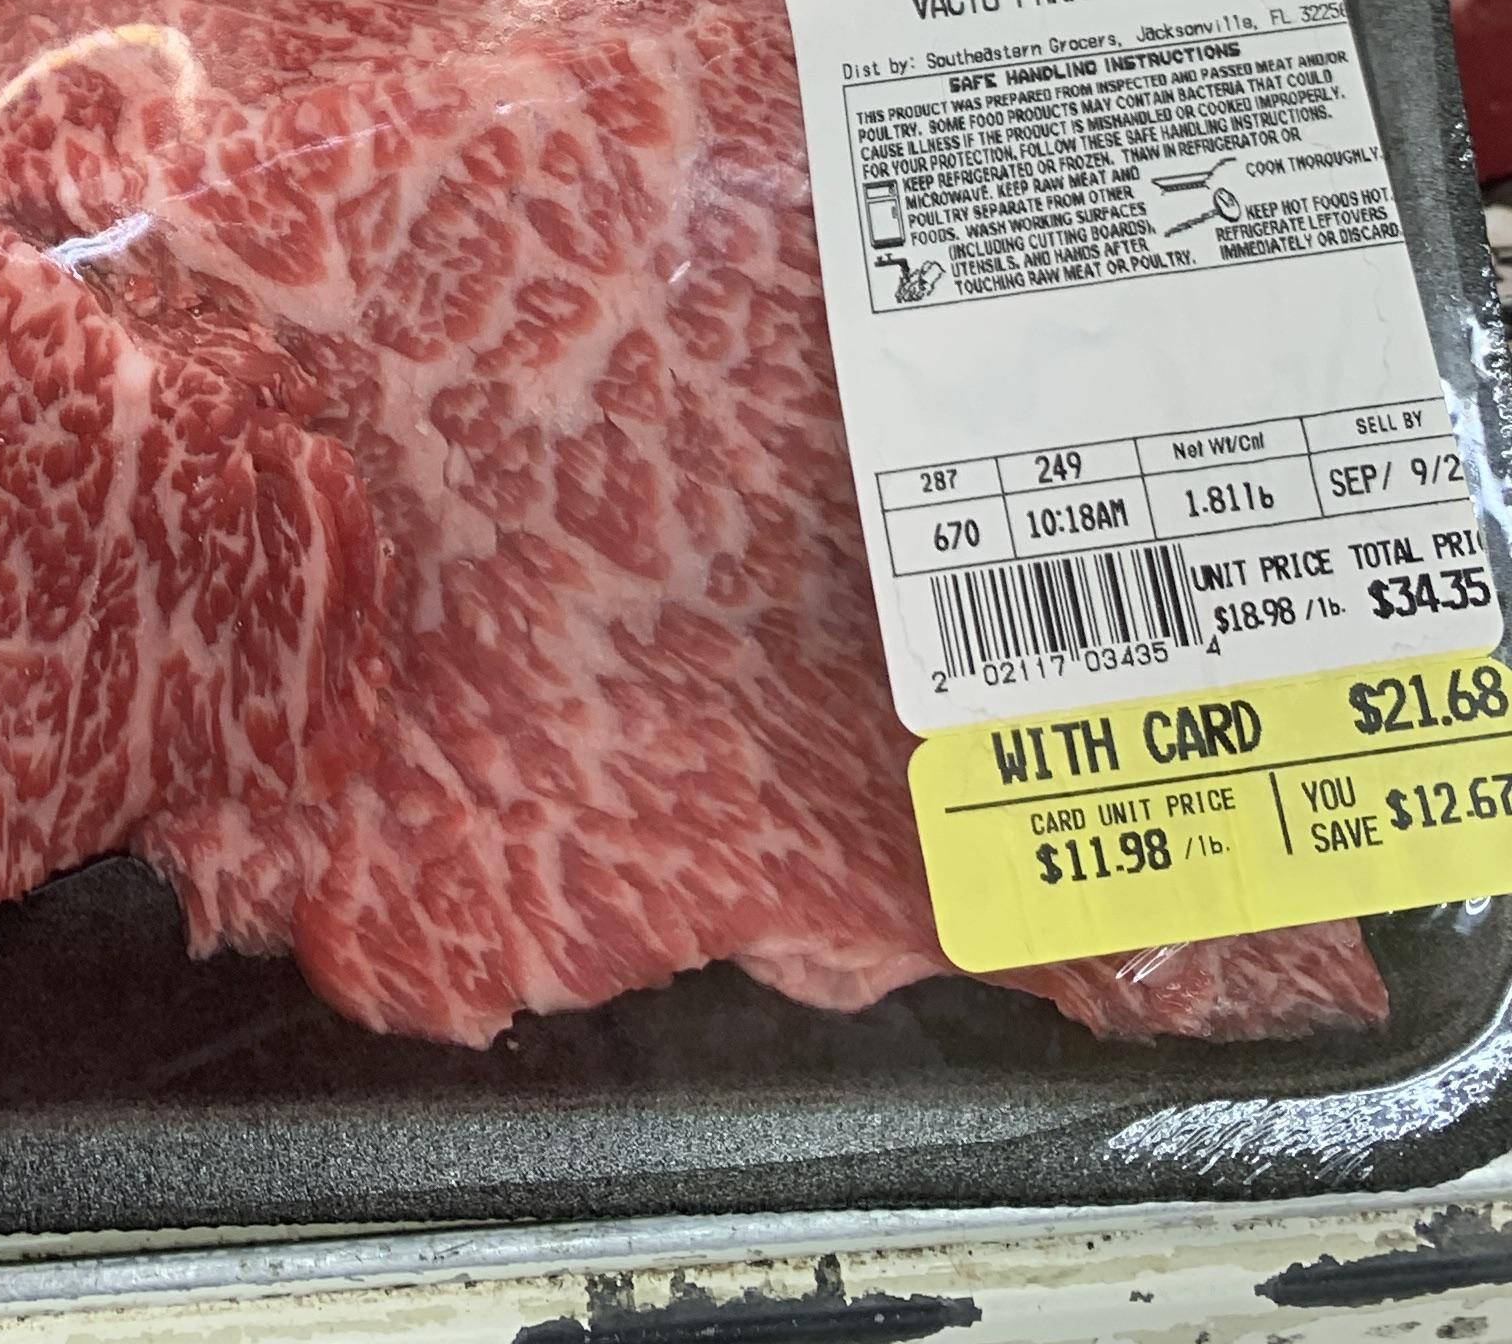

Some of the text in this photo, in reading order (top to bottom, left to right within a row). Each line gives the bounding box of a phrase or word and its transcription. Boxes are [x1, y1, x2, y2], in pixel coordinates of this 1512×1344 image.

[842, 61, 880, 79] Dist
[888, 56, 914, 75] by:
[926, 44, 1042, 69] Southeastern
[1048, 34, 1122, 53] Grocers,
[1136, 14, 1257, 42] Jacksonville,
[1269, 8, 1291, 25] FL
[948, 72, 997, 93] SAFE
[1104, 41, 1240, 72] INSTRUCTIONS
[855, 109, 884, 125] THIS
[887, 100, 947, 121] PRODUCT
[950, 96, 982, 112] WAS
[985, 87, 1052, 108] PREPARED
[1054, 82, 1092, 99] FROM
[1095, 73, 1167, 93] INSPECTED
[1170, 69, 1197, 84] AND
[1200, 62, 1252, 80] PASSED
[1254, 56, 1292, 73] MEAT
[858, 68, 1332, 143] POULTRY. SOME FOOD PRODUCTS MAY CONTAIN BACTERIA THAT COULD
[860, 85, 1345, 161] CAUSE ILLNESS IF THE PRODUCT IS MISHANDLED OR COOKED IMPROPERLY.
[862, 161, 890, 179] FOR
[891, 156, 928, 175] YOUR
[1019, 137, 1076, 159] FOLLOW
[1079, 130, 1122, 150] THESE
[1125, 126, 1158, 145] SAFE
[1159, 117, 1228, 139] HANDLING
[1229, 104, 1332, 131] INSTRUCTIONS.
[902, 126, 1302, 192] KEEP REFRIGERATED OR FROZEN. THAW IN REFRIGERATOR OR
[910, 201, 1146, 246] FOODS. WASH WORKING SURFACES
[1215, 205, 1388, 242] REFRIGERATE LEFTOVERS
[1244, 201, 1278, 220] KEEP
[1280, 197, 1308, 215] HOT
[1311, 190, 1358, 211] FOODS
[954, 249, 1196, 295] TOUCHING RAW MEAT OR POULTRY.
[1356, 410, 1422, 435] SELL BY
[920, 453, 1081, 493] 287 249
[933, 520, 980, 550] 670
[1027, 498, 1128, 538] 10:18AM
[1191, 548, 1333, 593] UNIT PRICE
[1348, 537, 1424, 570] TOTAL
[1215, 598, 1297, 636] $18.98
[1368, 566, 1491, 619] $34.35
[932, 634, 1222, 693] 2 02117 03435 4
[1349, 665, 1509, 735] $21.68
[991, 699, 1263, 784] WITH CARD
[1031, 788, 1236, 836] CARD UNIT PRICE
[1301, 777, 1355, 812] YOU
[1311, 773, 1512, 853] SAVE $12.67
[1035, 828, 1171, 885] $11.98
